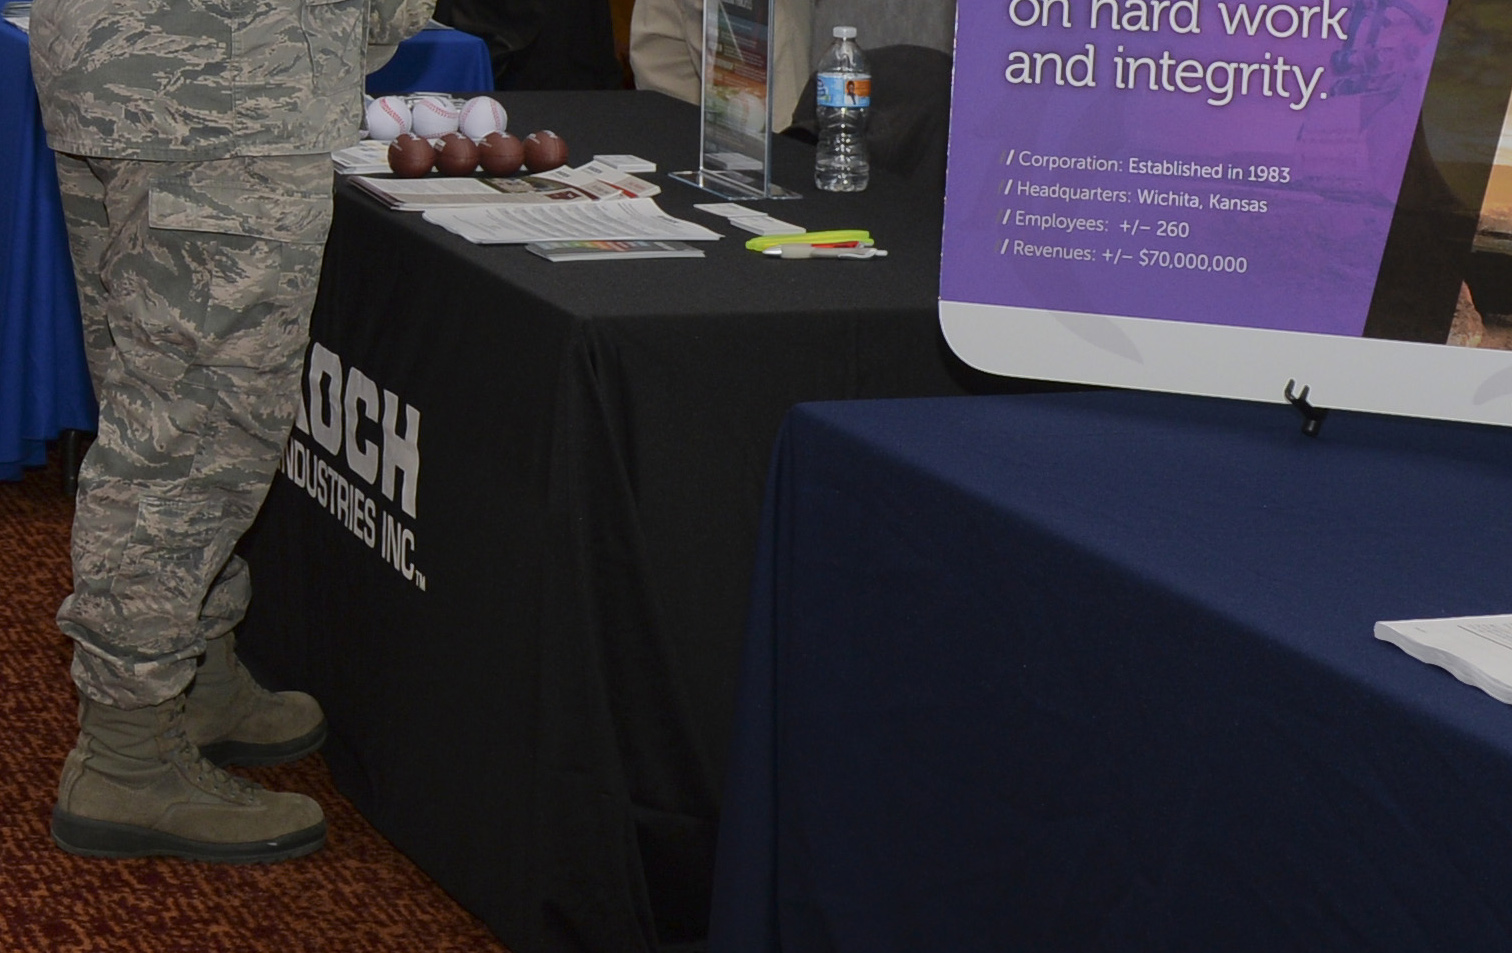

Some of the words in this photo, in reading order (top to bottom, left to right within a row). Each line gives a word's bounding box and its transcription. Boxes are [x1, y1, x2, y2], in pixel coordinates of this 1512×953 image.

[1005, 44, 1096, 87] and
[1114, 45, 1328, 110] integrity.
[1018, 150, 1123, 172] Corporation:
[1128, 158, 1223, 179] Established
[1227, 164, 1243, 181] in
[1248, 165, 1290, 183] 1983
[1017, 181, 1132, 203] Headquarters:
[1137, 189, 1204, 210] Wichita,
[1209, 195, 1268, 213] Kansas
[1015, 210, 1109, 233] Employees:
[1156, 220, 1190, 238] 260
[1013, 240, 1096, 262] Revenues:
[1139, 248, 1248, 274] $70,000,000
[295, 341, 421, 520] OCH
